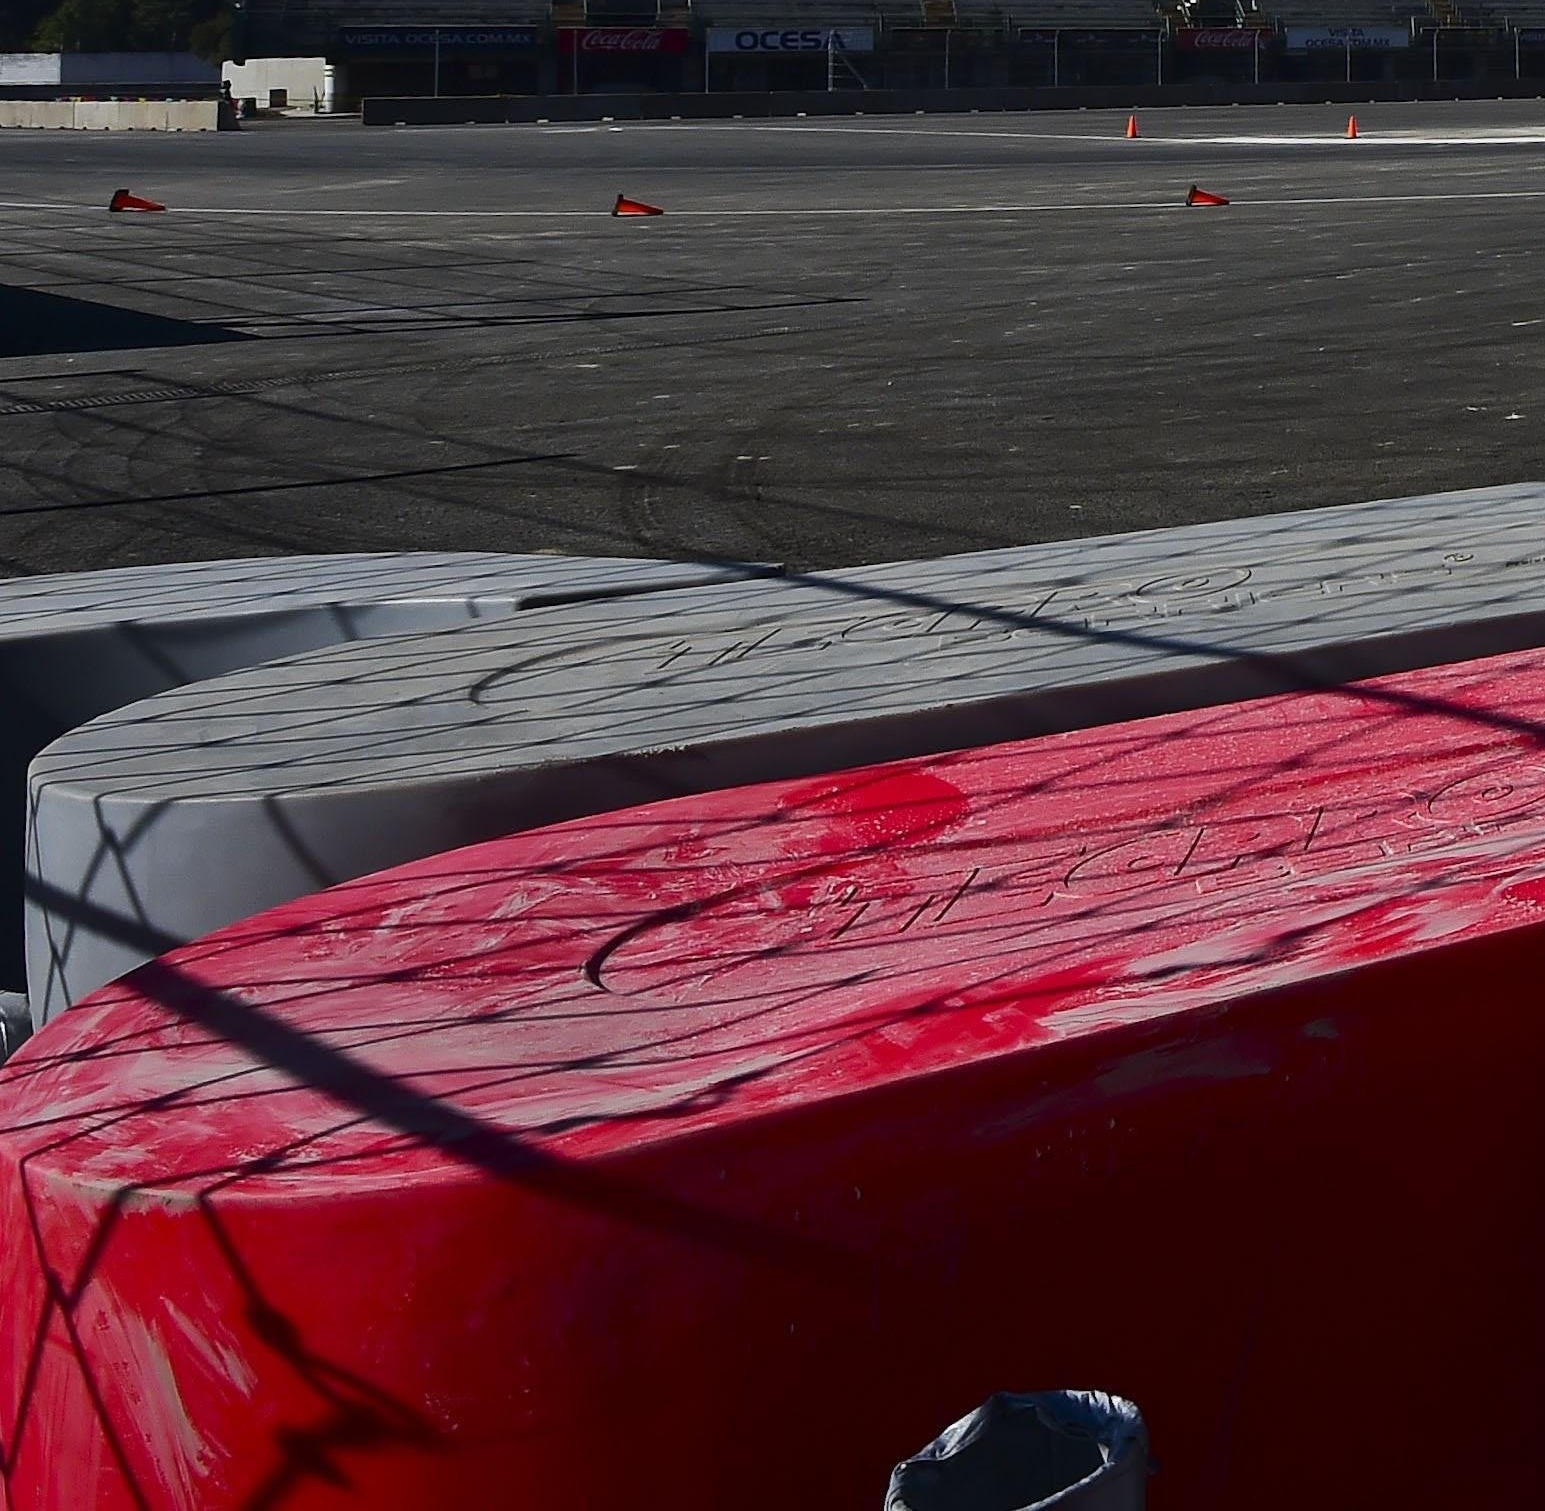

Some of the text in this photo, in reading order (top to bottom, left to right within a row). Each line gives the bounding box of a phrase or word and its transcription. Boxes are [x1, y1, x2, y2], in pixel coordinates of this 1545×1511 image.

[345, 33, 399, 44] VISITA
[582, 29, 664, 50] Coca-Cola
[1328, 28, 1365, 37] VISITA
[734, 31, 847, 50] OCESA
